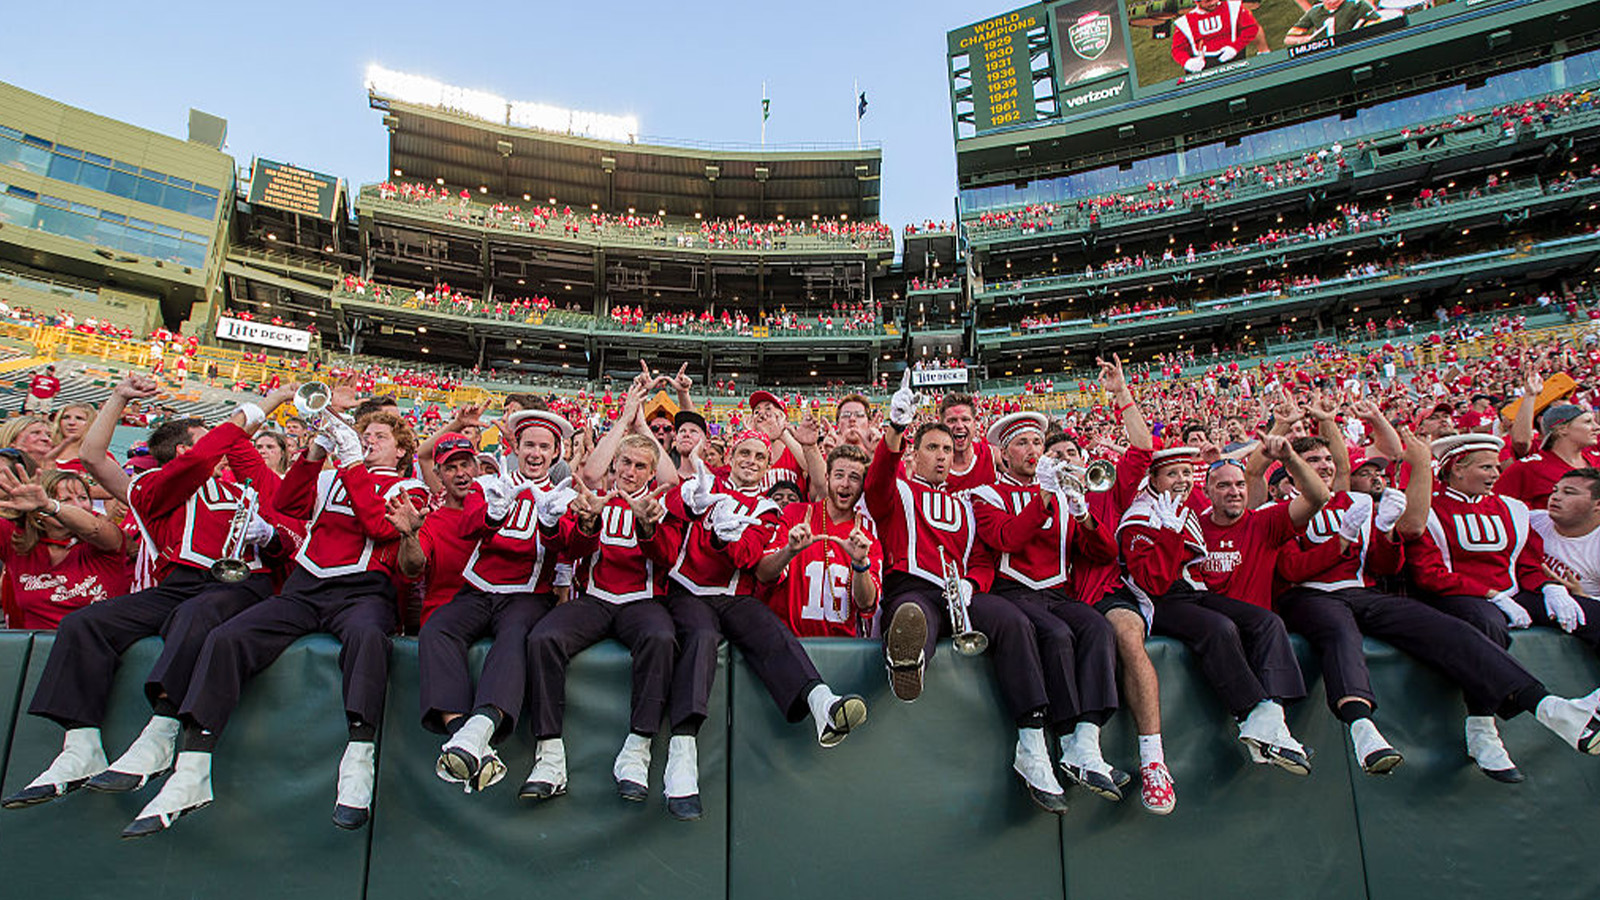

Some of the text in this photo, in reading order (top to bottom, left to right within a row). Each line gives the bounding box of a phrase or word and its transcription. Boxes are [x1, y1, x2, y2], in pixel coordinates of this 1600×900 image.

[974, 12, 1020, 34] WORLD
[960, 17, 1036, 48] CHAMPIONS
[983, 35, 1012, 51] 1929
[984, 45, 1014, 61] 1930
[985, 57, 1011, 72] 1931
[986, 66, 1016, 82] 1936
[988, 77, 1017, 93] 1939
[989, 88, 1018, 104] 1944
[1066, 85, 1121, 108] verizon
[990, 99, 1017, 114] 1961
[991, 110, 1020, 126] 1962
[228, 321, 293, 343] Lite DECK
[801, 560, 850, 624] 16
